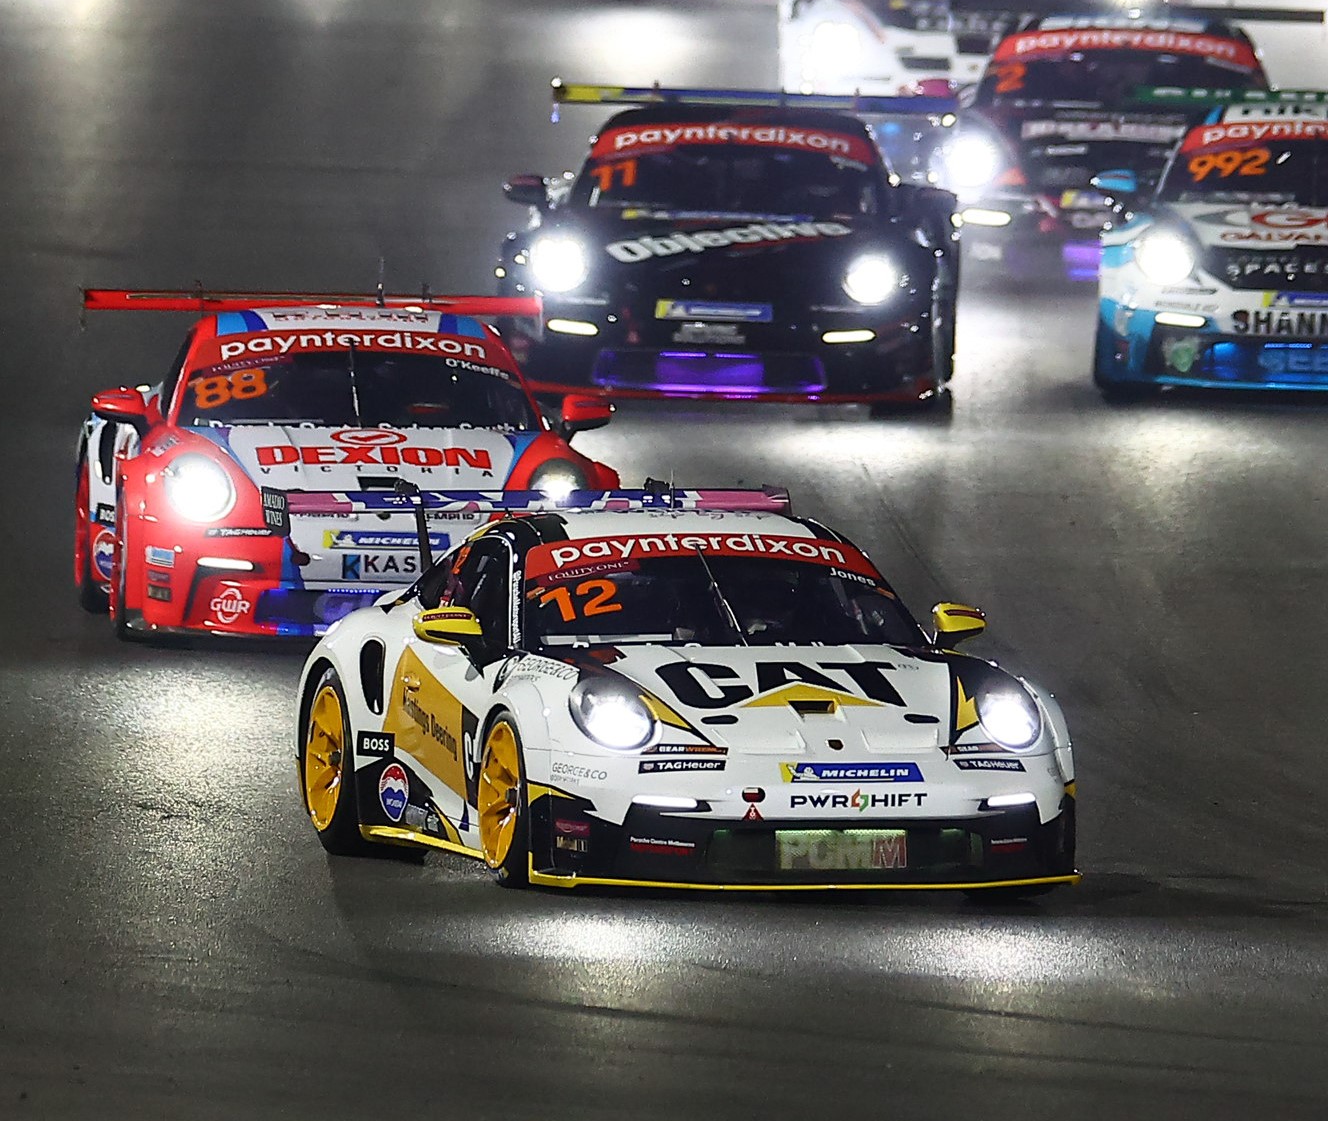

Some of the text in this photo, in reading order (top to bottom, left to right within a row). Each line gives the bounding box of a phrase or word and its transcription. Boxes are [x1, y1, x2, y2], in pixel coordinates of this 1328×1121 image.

[1014, 31, 1238, 57] paynterdixon
[994, 62, 1028, 94] 2
[613, 124, 851, 154] paynterdixon
[590, 160, 638, 192] 11
[1188, 148, 1272, 183] 992
[220, 329, 488, 362] paynterdixon
[191, 368, 269, 410] 88
[255, 445, 493, 472] DEXION
[265, 510, 283, 527] WINES
[358, 537, 441, 546] MICHELN
[550, 533, 847, 567] paynterdixon
[829, 566, 877, 588] Jones
[210, 596, 251, 615] GWR
[539, 578, 623, 623] 12
[655, 661, 908, 709] CAT
[363, 737, 390, 753] BOSS
[552, 762, 608, 780] GEORGE&CO
[820, 767, 910, 778] MICHELIN
